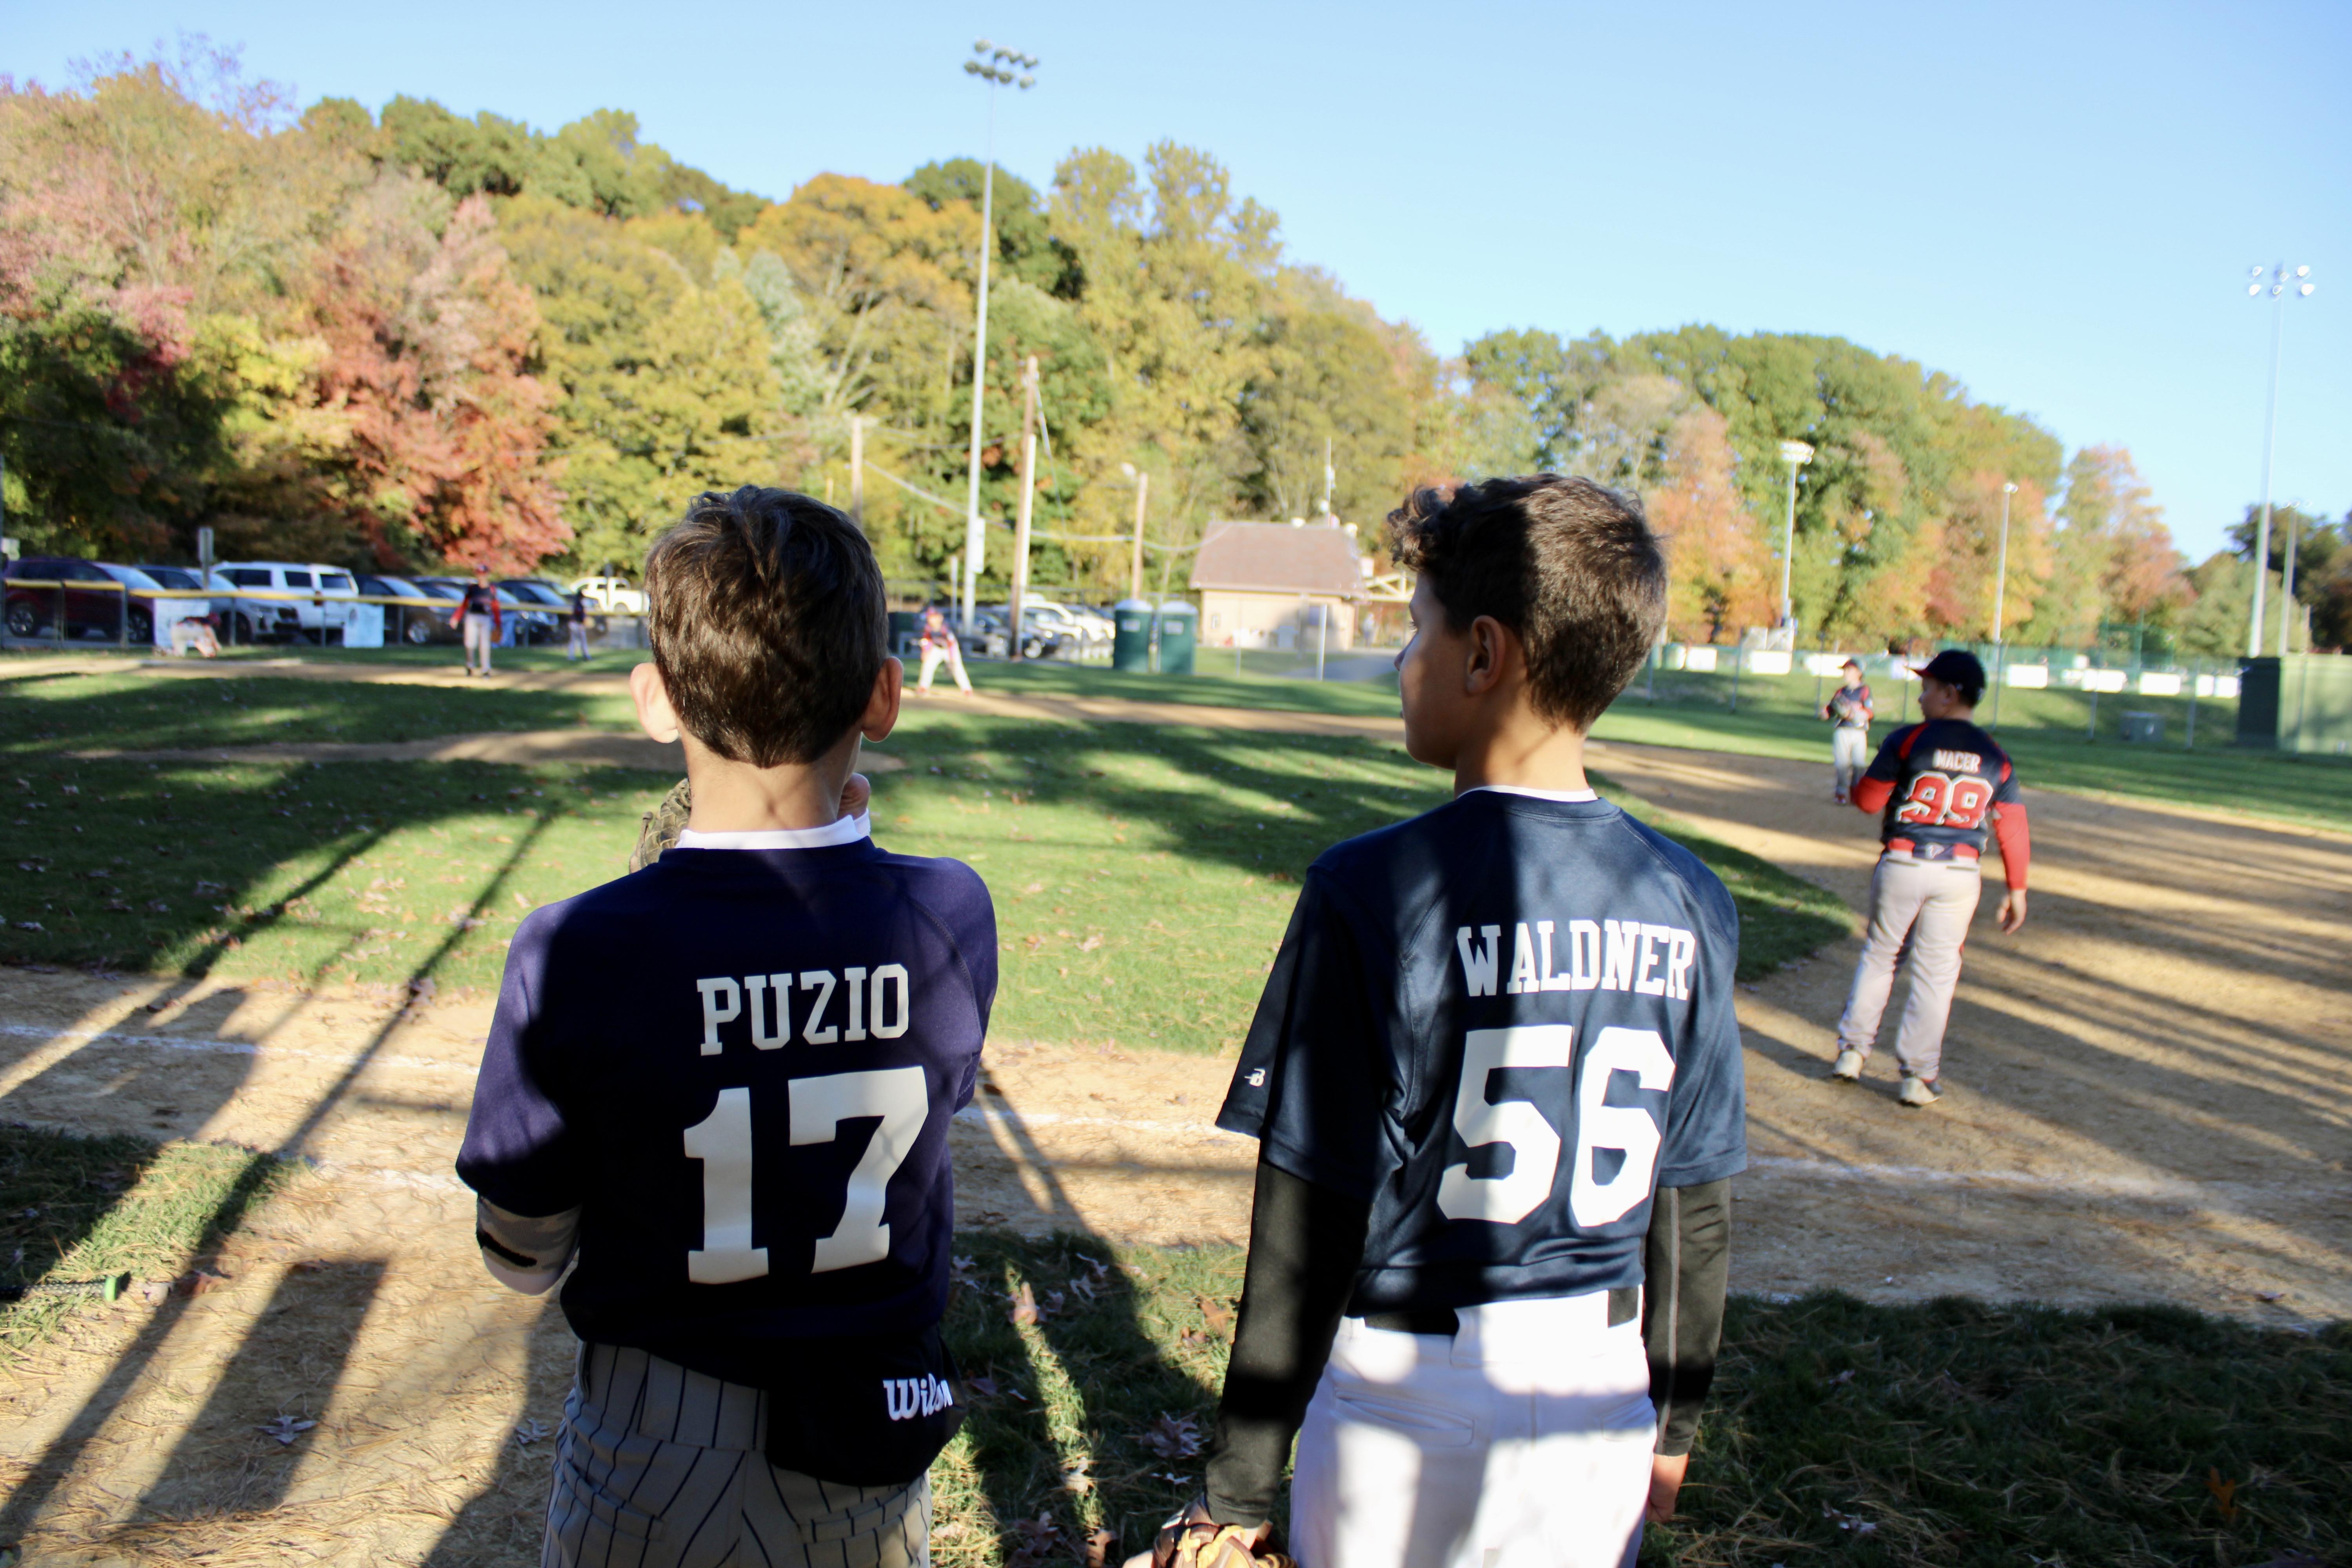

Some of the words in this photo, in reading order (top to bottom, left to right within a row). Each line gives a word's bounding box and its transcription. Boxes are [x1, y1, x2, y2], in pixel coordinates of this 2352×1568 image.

[1895, 771, 1993, 829] 99
[1457, 920, 1696, 1001] WALDNER
[697, 963, 909, 1056] PUZIO
[1437, 1024, 1676, 1227] 56
[684, 1065, 929, 1285] 17
[882, 1373, 953, 1421] Wilsn
